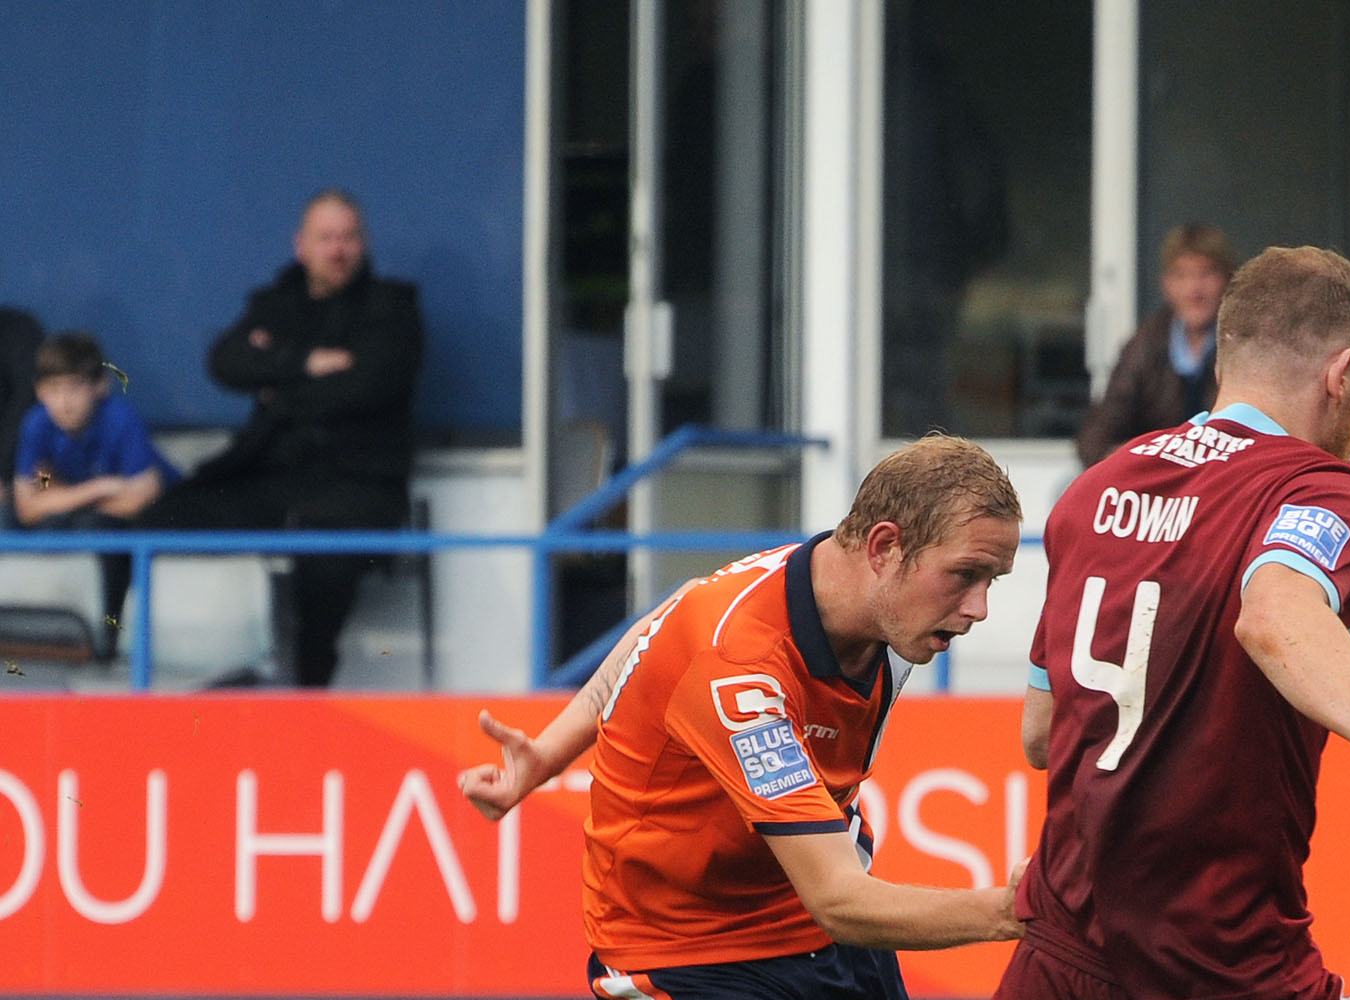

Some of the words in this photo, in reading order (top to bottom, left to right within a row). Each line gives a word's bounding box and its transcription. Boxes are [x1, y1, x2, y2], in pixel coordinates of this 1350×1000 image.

[1093, 486, 1200, 543] COWAN
[1283, 509, 1346, 543] BLUE
[1269, 532, 1330, 567] PREMIER
[1071, 576, 1161, 771] 4
[735, 725, 793, 759] BLUE
[753, 769, 812, 796] PREMIER
